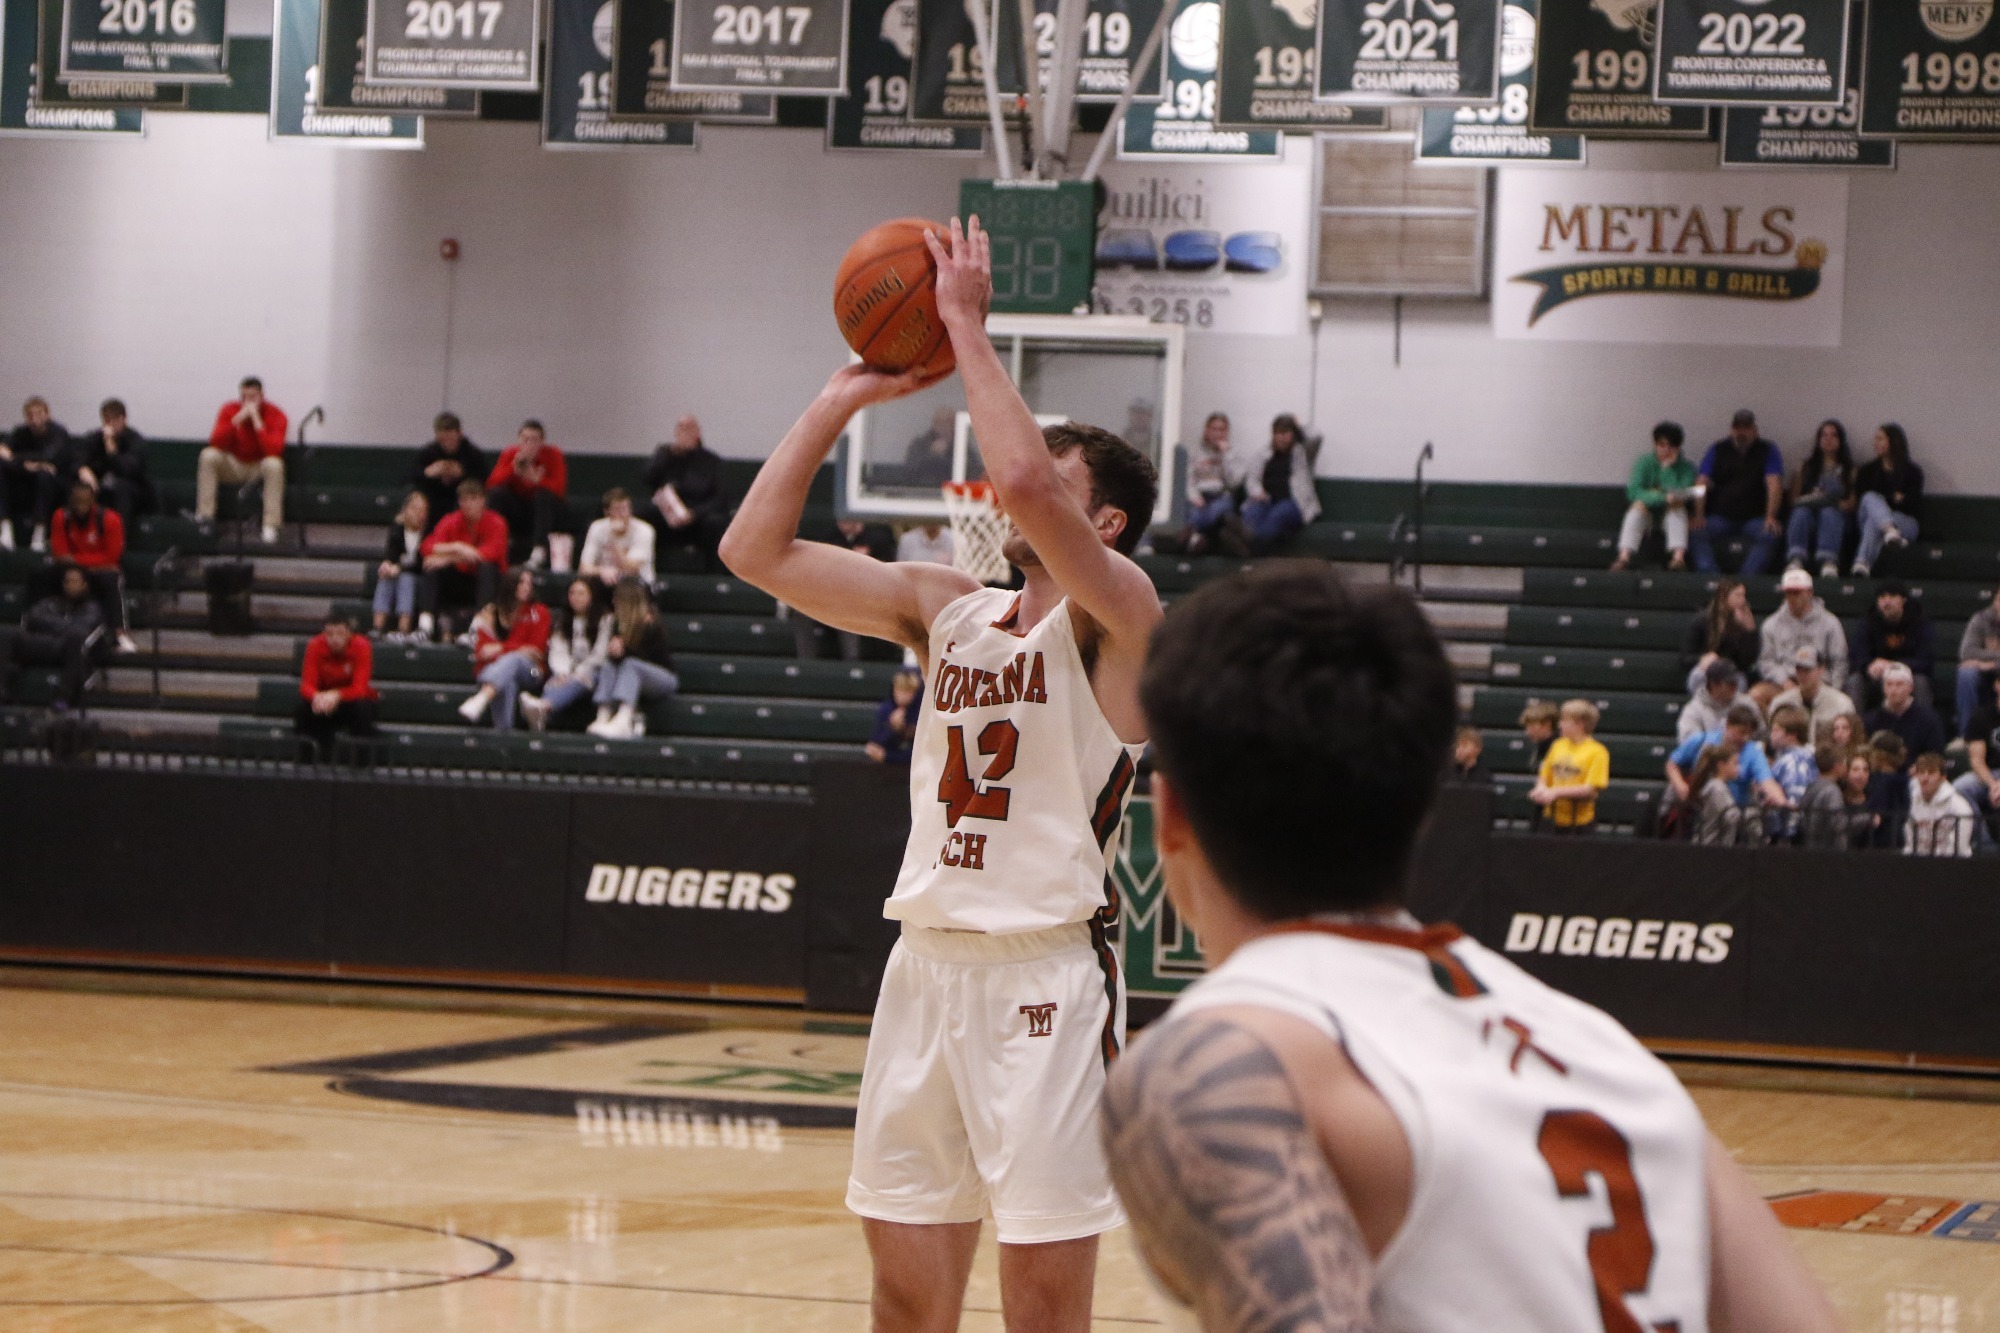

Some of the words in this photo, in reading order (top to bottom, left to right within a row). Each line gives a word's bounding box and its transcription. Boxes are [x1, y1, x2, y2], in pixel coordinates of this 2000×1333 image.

[98, 0, 196, 34] 2016
[405, 1, 502, 39] 2017
[712, 5, 811, 44] 2017
[1927, 5, 1985, 25] MEN'S
[1359, 19, 1458, 60] 2021
[1698, 13, 1805, 55] 2022
[1571, 49, 1648, 90] 199
[1673, 56, 1733, 71] FRONTIER
[1734, 57, 1815, 73] CONFERENCE
[1816, 59, 1827, 73] &
[1901, 52, 2000, 92] 1998
[68, 81, 157, 98] CHAMPIONS
[1352, 72, 1460, 91] CHAMPIONS
[1667, 72, 1753, 88] TOURNAMENT
[1755, 74, 1832, 91] CHAMPIONS
[352, 87, 447, 105] CHAMPIONS
[645, 93, 742, 110] CHAMPIONS
[864, 75, 908, 113] 19
[26, 109, 116, 129] CHAMPIONS
[1251, 101, 1353, 120] CHAMPIONS
[1566, 104, 1671, 123] CHAMPIONS
[1897, 109, 2000, 127] CHAMPIONS
[302, 116, 393, 135] CHAMPIONS
[574, 122, 668, 140] CHAMPIONS
[860, 127, 955, 145] CHAMPIONS
[1151, 131, 1249, 151] CHAMPIONS
[1450, 135, 1551, 156] CHAMPIONS
[1757, 140, 1859, 159] CHAMPIONS
[1539, 204, 1798, 257] METALS
[1562, 267, 1646, 294] SPORTS
[1653, 267, 1697, 287] BAR
[1727, 273, 1792, 294] GRILL
[937, 718, 1019, 828] 42
[585, 863, 796, 913] DIGGERS
[1504, 912, 1734, 963] DIGGERS
